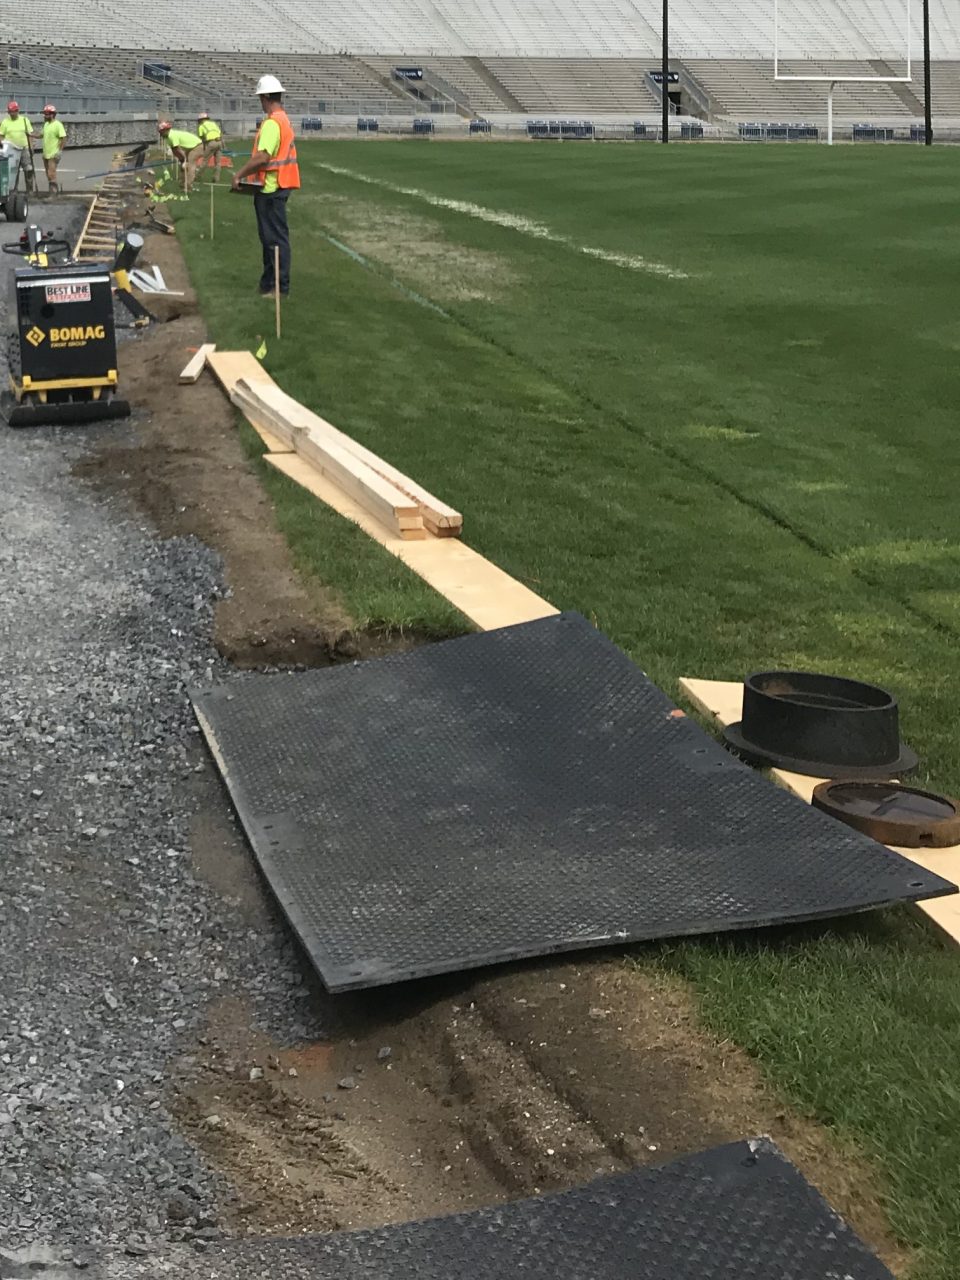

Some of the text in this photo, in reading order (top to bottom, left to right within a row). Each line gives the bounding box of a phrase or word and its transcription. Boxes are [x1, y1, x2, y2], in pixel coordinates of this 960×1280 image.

[47, 283, 90, 296] BEST LINE
[50, 325, 105, 341] BOMAG
